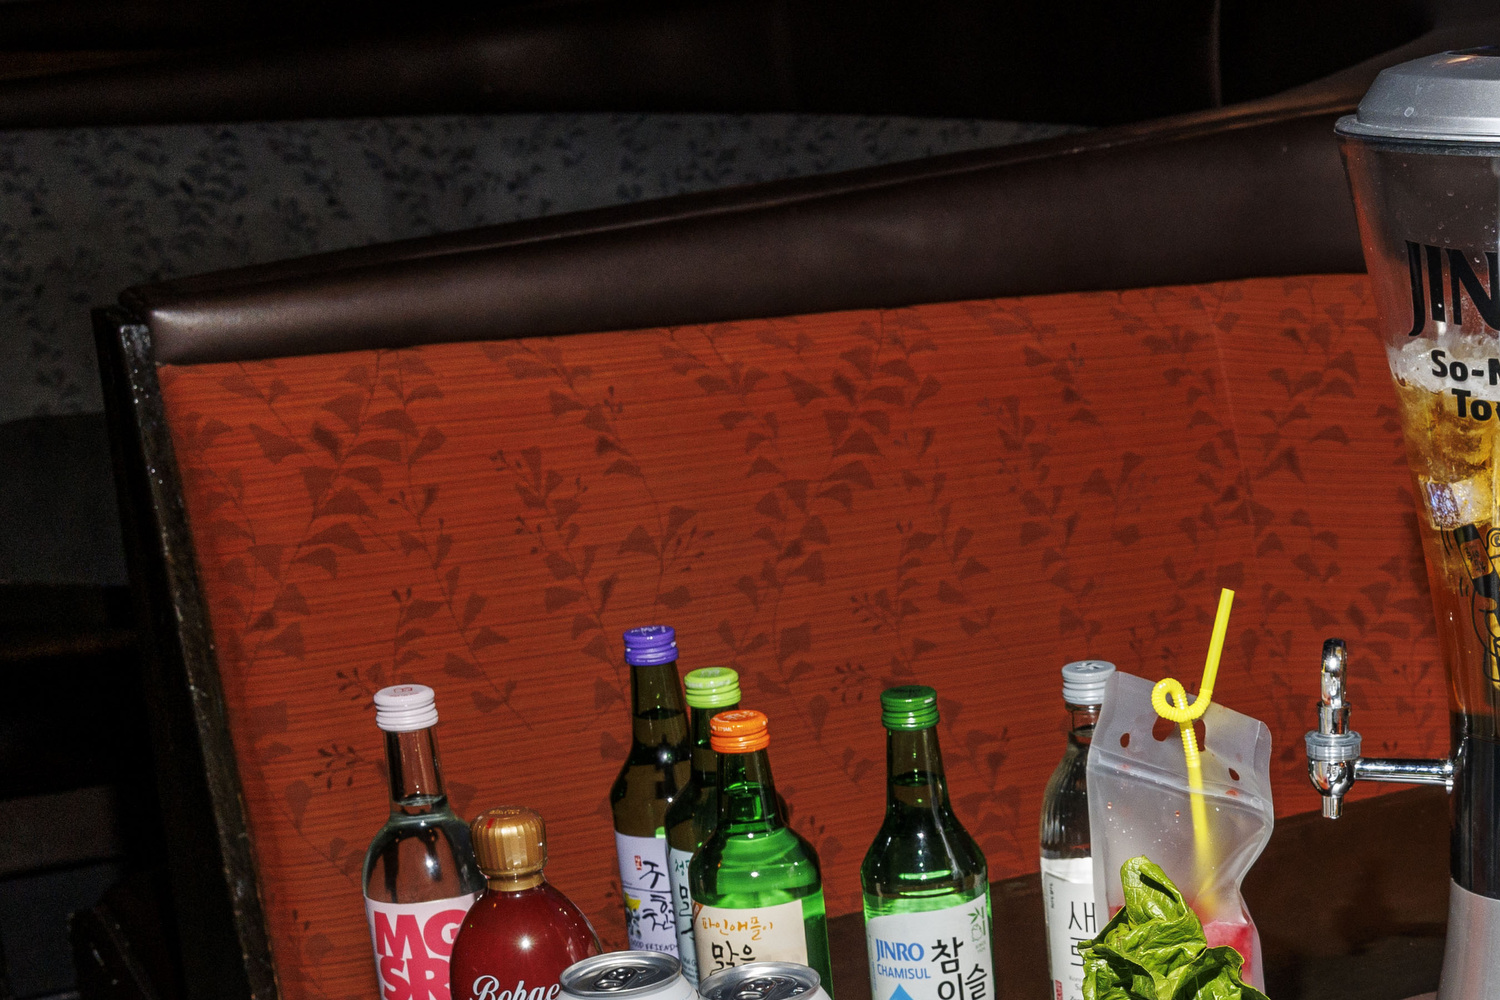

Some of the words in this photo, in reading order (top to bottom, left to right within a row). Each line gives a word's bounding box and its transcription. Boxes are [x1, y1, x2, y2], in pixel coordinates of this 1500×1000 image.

[373, 909, 467, 959] MG
[701, 916, 774, 941] 파인애플이
[875, 938, 925, 962] JINRO
[877, 963, 932, 979] CHAMISUL
